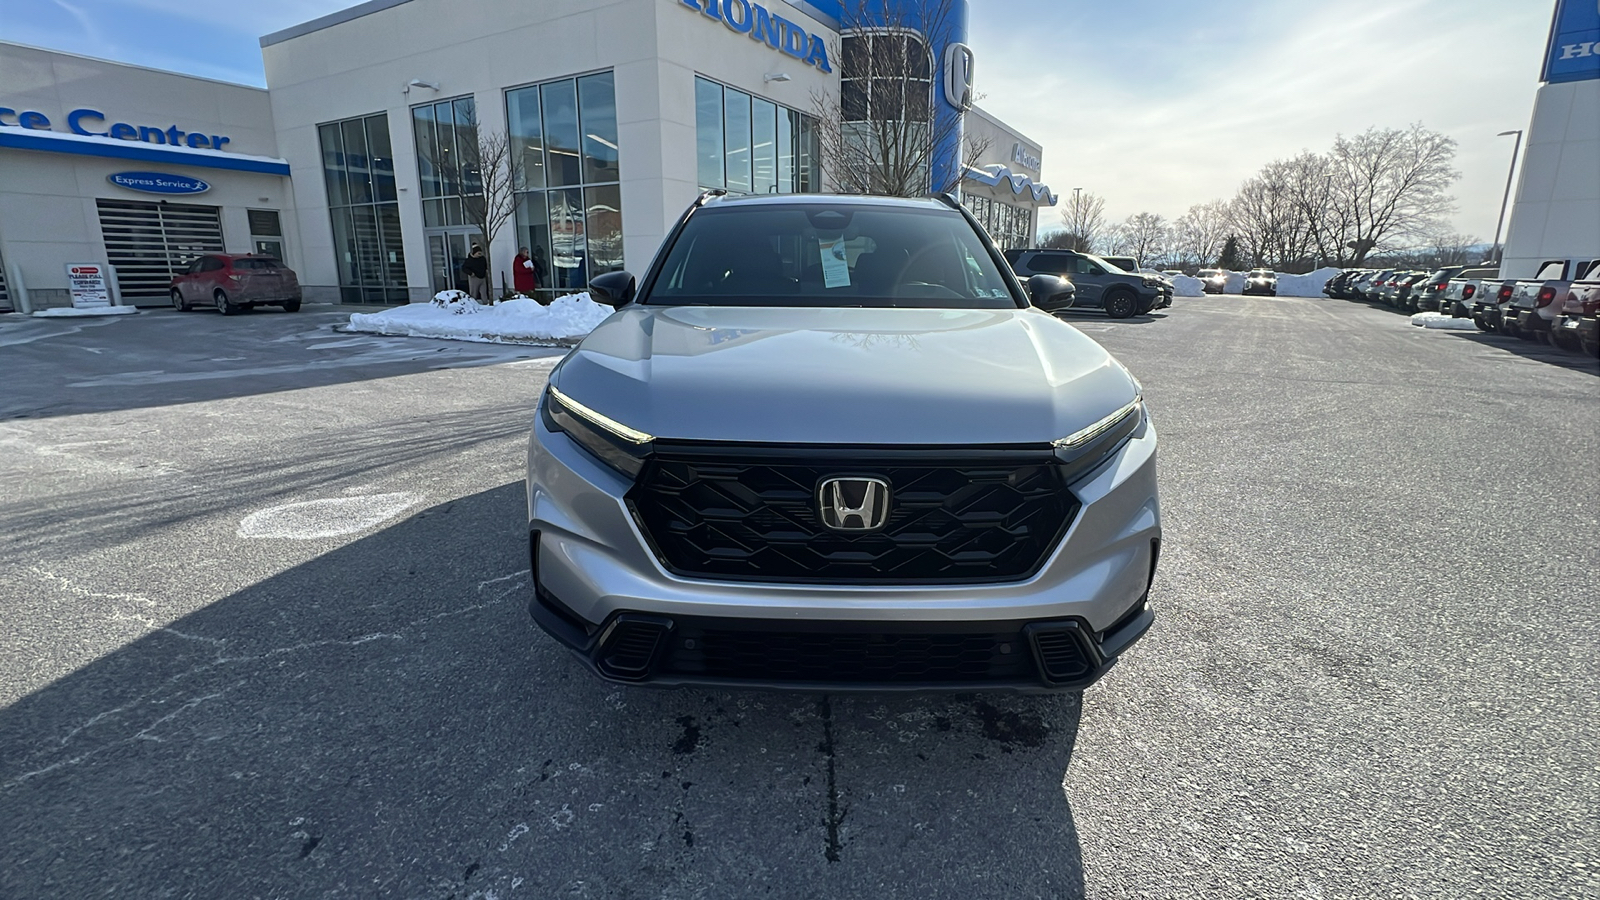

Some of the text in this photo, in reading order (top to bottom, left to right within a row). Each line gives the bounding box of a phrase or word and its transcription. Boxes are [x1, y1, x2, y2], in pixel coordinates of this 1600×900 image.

[679, 0, 832, 74] ONDA
[67, 108, 231, 151] Center
[115, 175, 191, 188] Express Service
